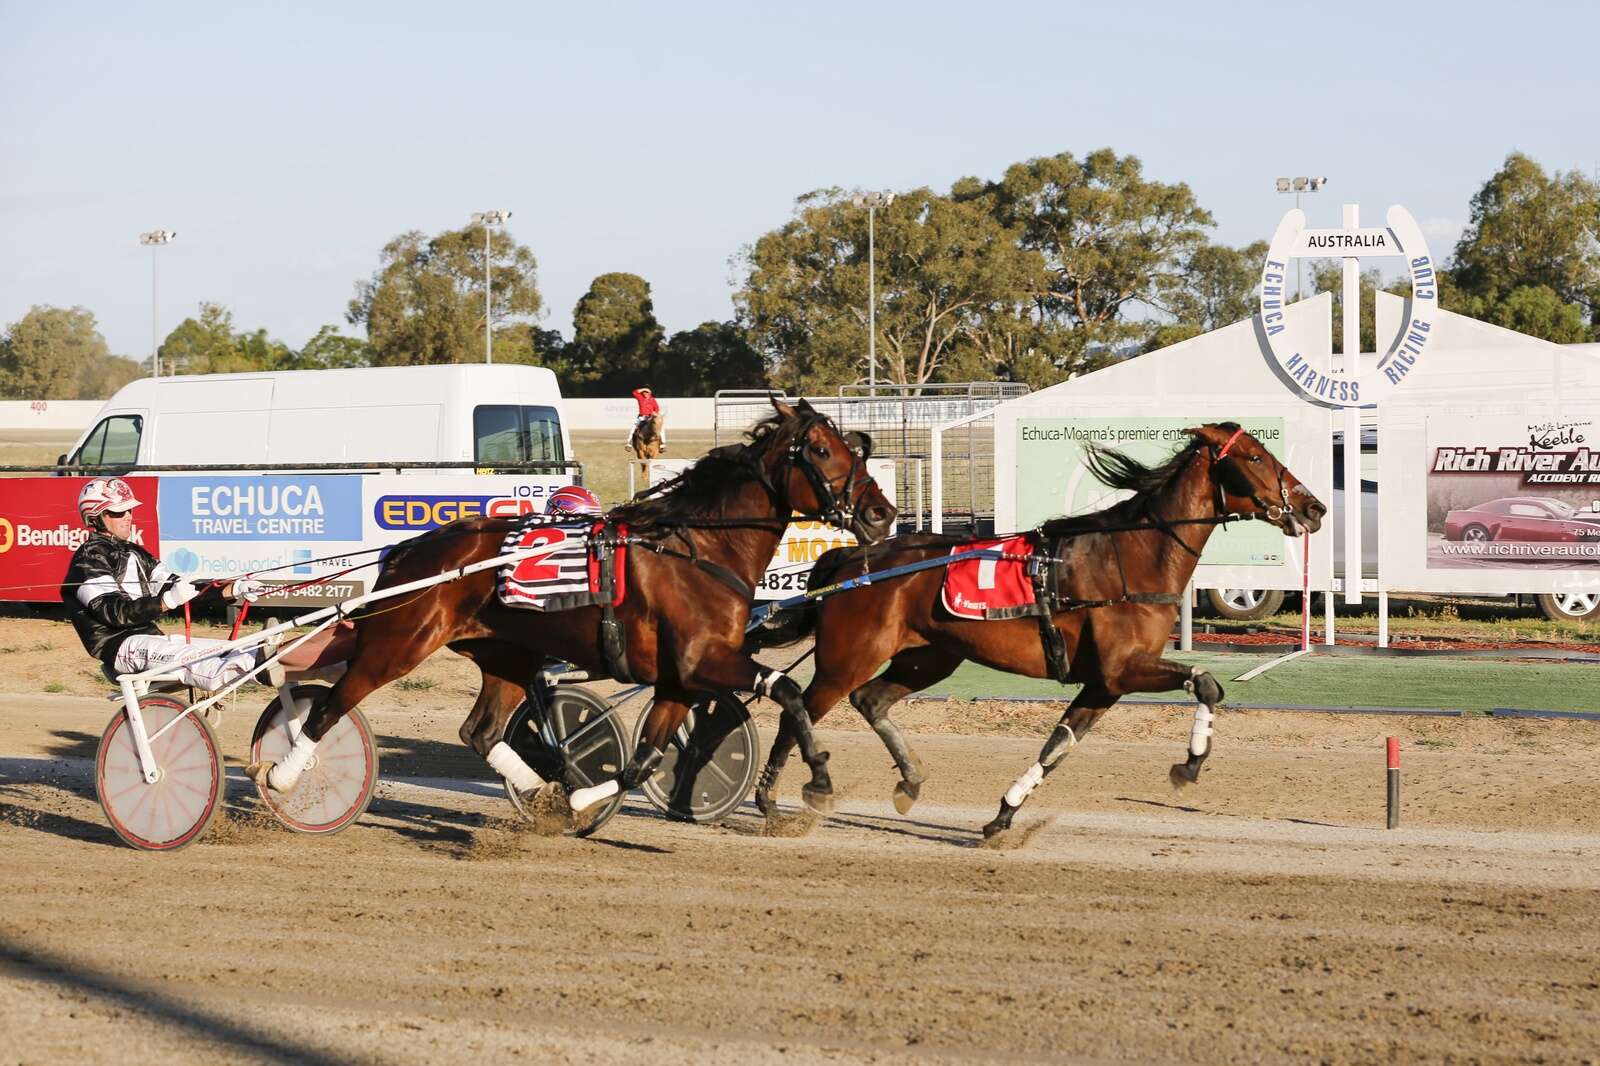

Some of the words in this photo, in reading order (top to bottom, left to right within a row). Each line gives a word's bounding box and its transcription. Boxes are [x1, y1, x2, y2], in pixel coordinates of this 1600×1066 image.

[1308, 235, 1386, 248] AUSTRALIA
[1263, 260, 1285, 336] ECHUCA
[1286, 353, 1359, 401] HARNESS
[1384, 319, 1431, 385] RACING
[1411, 255, 1434, 300] CLUB
[31, 401, 48, 412] 400
[1118, 427, 1158, 444] premier
[1529, 427, 1585, 452] Keeble
[1434, 448, 1491, 471] Rich
[1496, 448, 1567, 471] River
[1527, 473, 1587, 483] ACCIDENT
[191, 485, 325, 516] ECHUCA
[383, 501, 481, 526] EDGE
[192, 518, 253, 534] TRAVEL
[256, 518, 325, 535] CENTRE
[512, 527, 567, 582] 2
[978, 543, 1004, 590] 1
[292, 584, 323, 598] 5482
[325, 584, 354, 598] 2177
